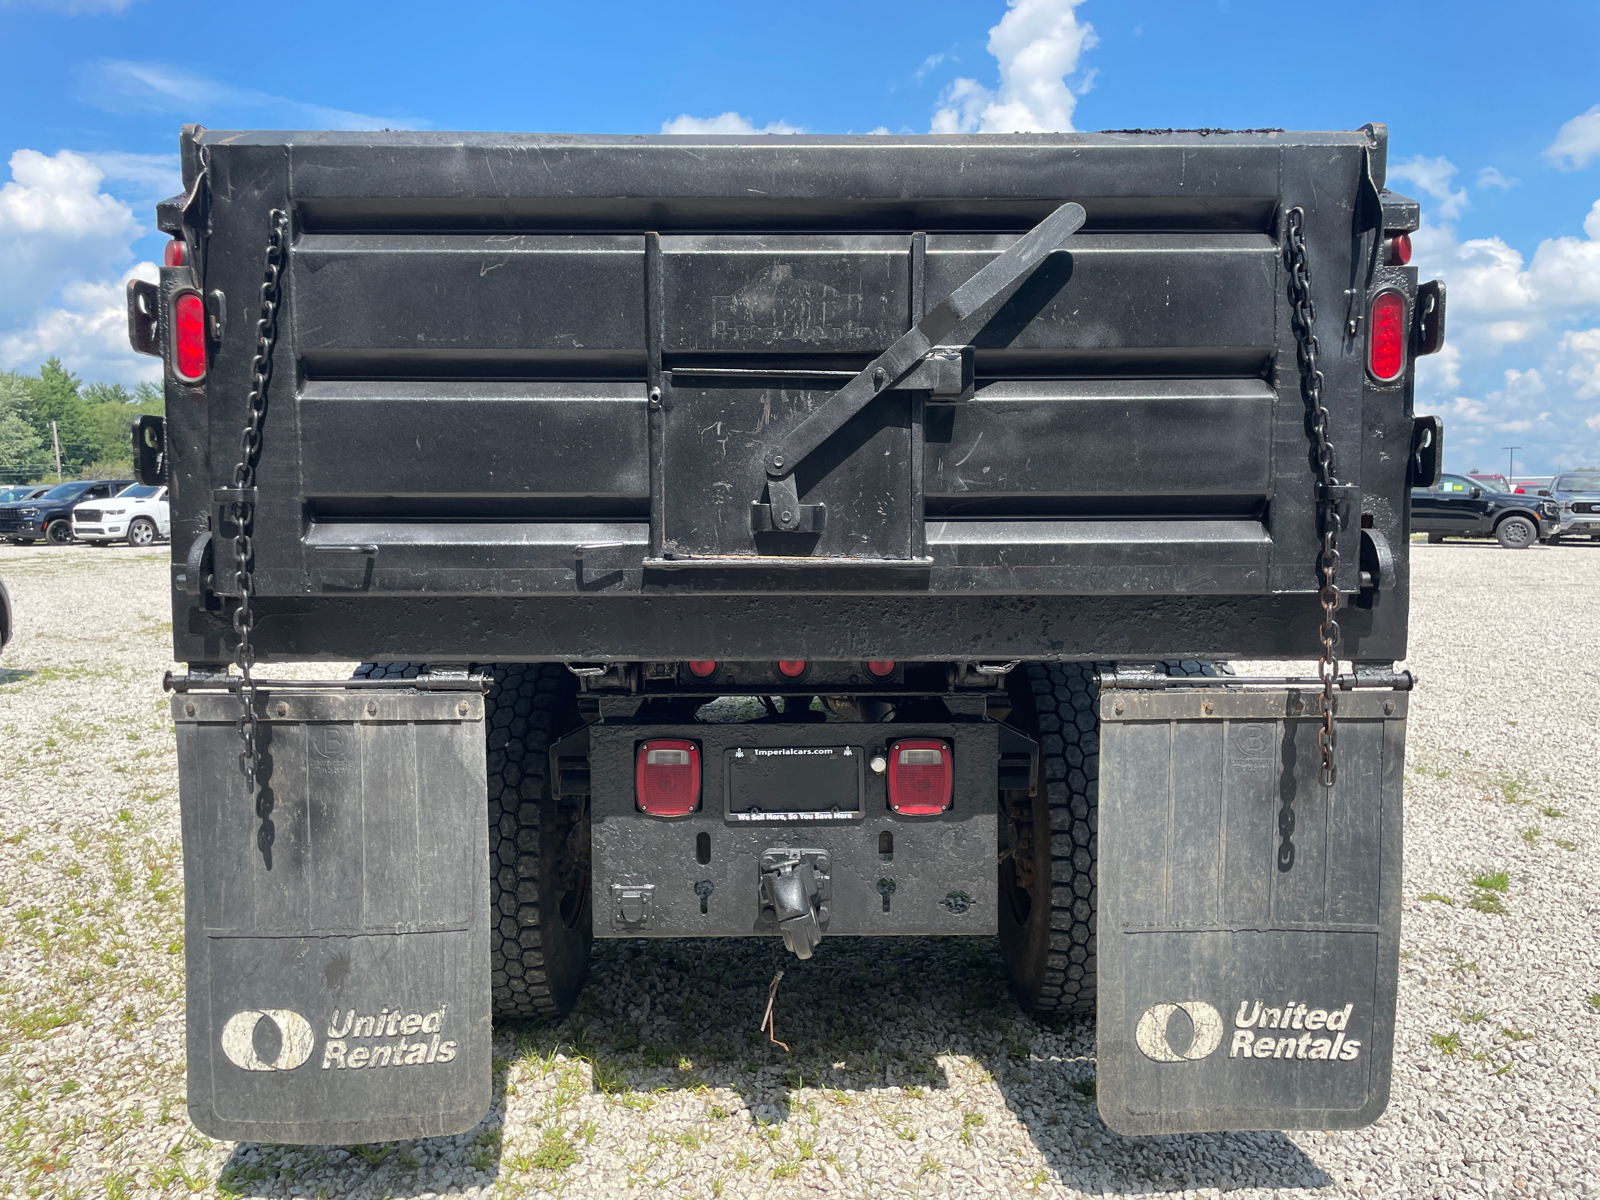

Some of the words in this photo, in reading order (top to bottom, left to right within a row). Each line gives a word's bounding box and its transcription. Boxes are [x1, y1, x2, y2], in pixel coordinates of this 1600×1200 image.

[754, 748, 833, 757] Imperialcars.com
[766, 813, 787, 821] More,
[814, 812, 833, 820] Save
[327, 1002, 449, 1038] United
[1234, 999, 1354, 1031] United
[321, 1034, 458, 1071] Rentals
[1228, 1030, 1362, 1061] Rentals
